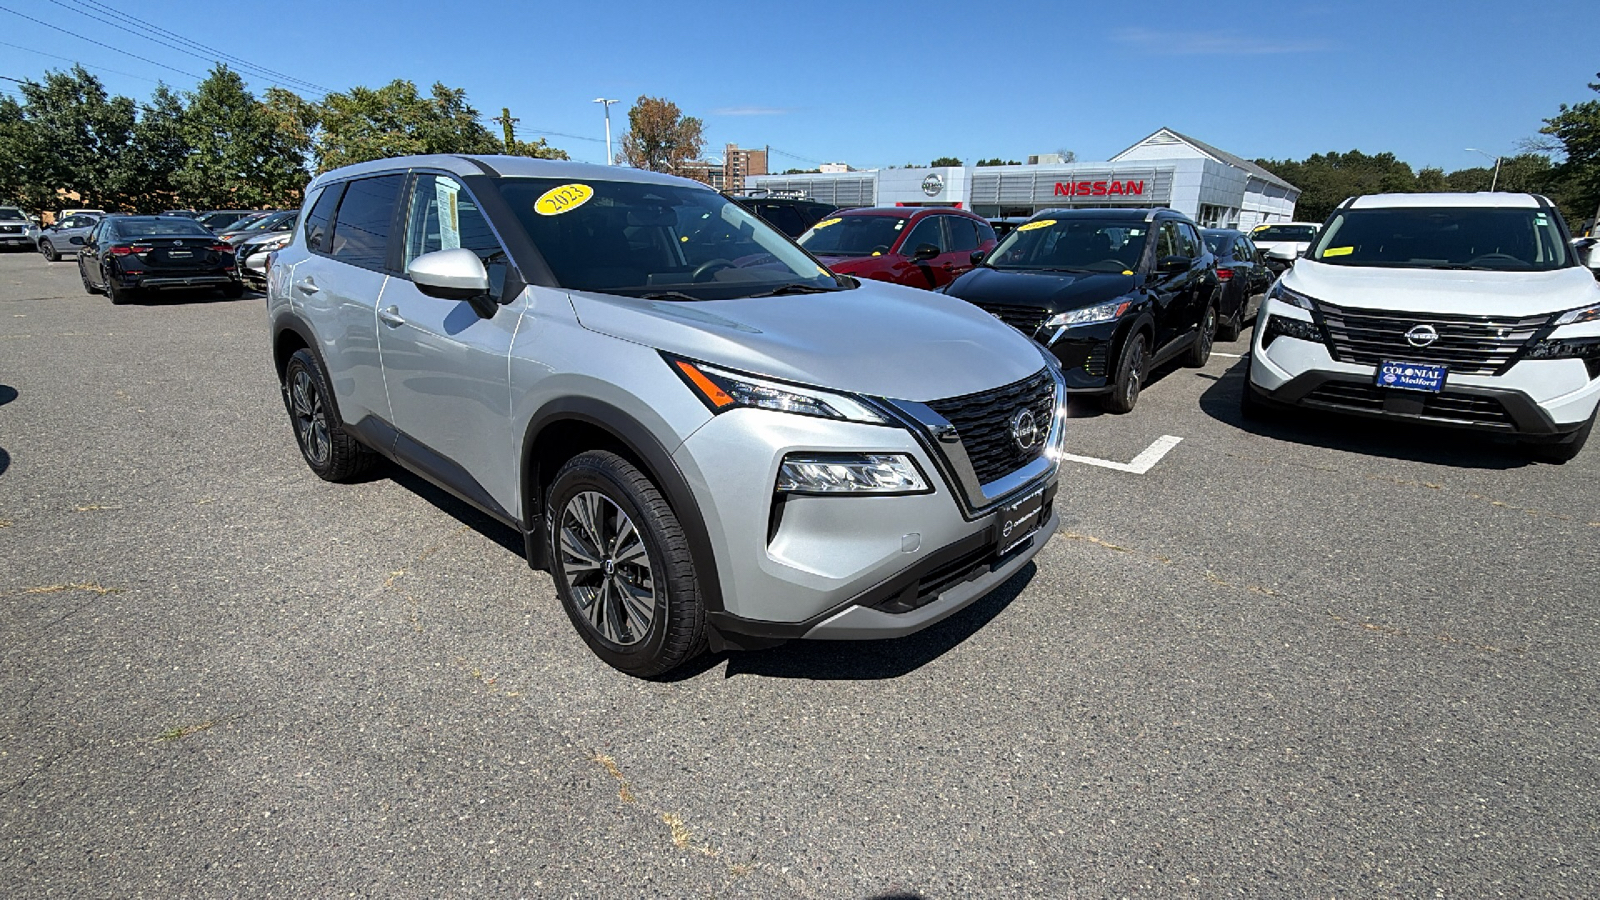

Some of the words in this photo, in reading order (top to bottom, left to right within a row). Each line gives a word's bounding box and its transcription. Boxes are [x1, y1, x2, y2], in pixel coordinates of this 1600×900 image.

[1054, 180, 1144, 196] NISSAN
[545, 186, 584, 211] 2023
[1383, 366, 1441, 379] COLONIAL
[1400, 376, 1437, 387] Medford
